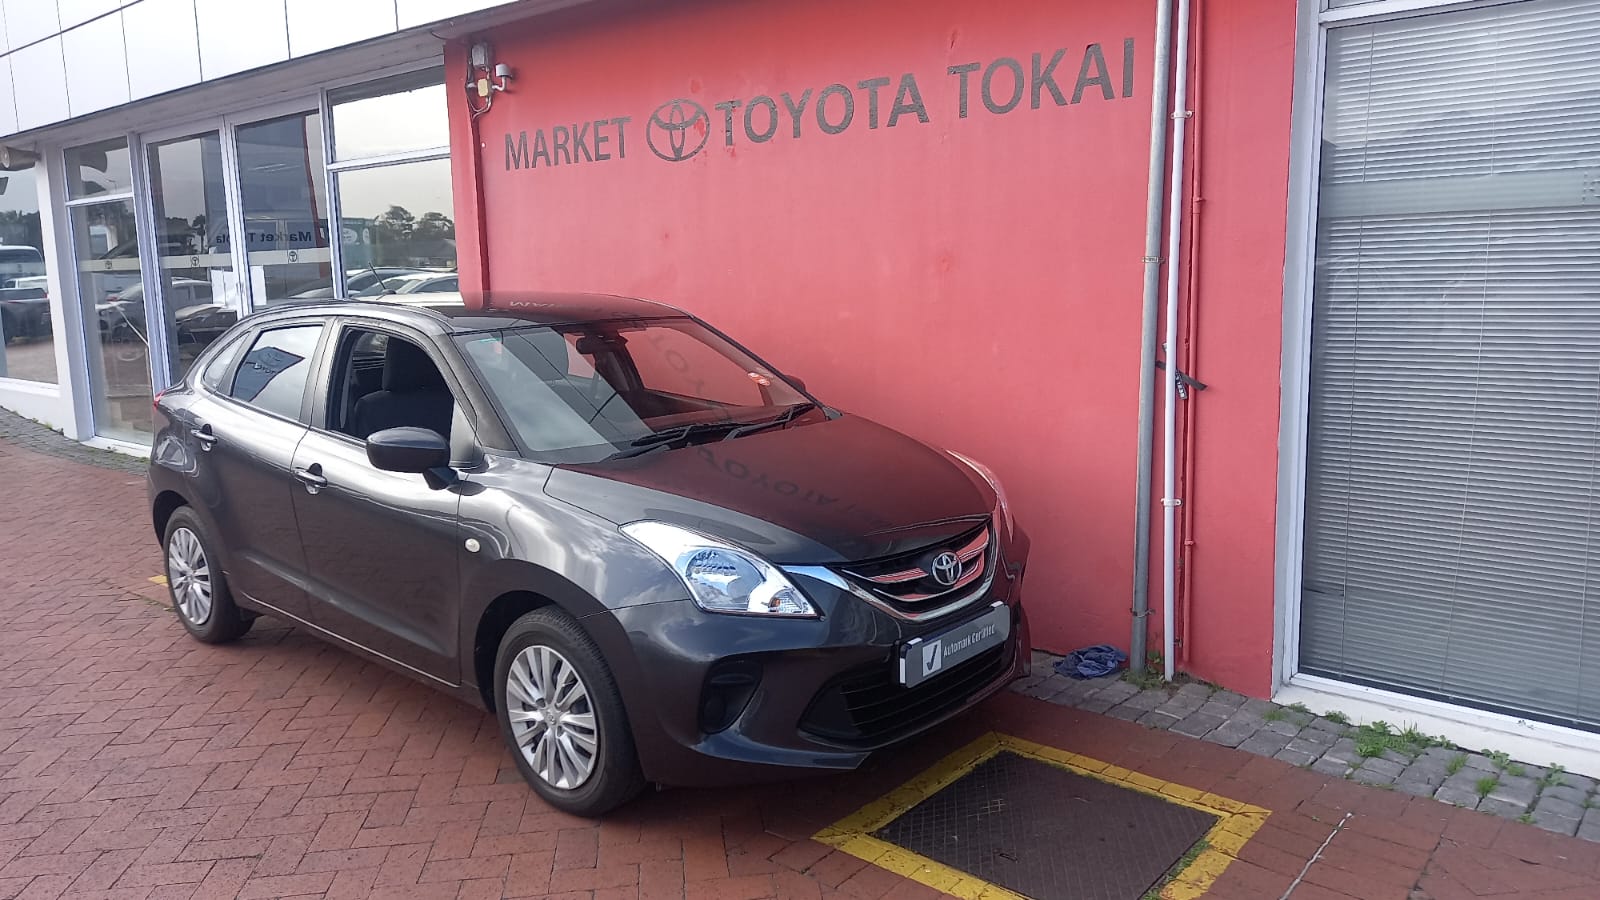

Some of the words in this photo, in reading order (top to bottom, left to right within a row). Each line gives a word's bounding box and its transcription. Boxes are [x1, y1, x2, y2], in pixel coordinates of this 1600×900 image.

[504, 116, 632, 171] MARKET
[715, 73, 930, 146] TOYOTA
[947, 37, 1135, 119] TOKAI
[943, 635, 971, 657] Automark
